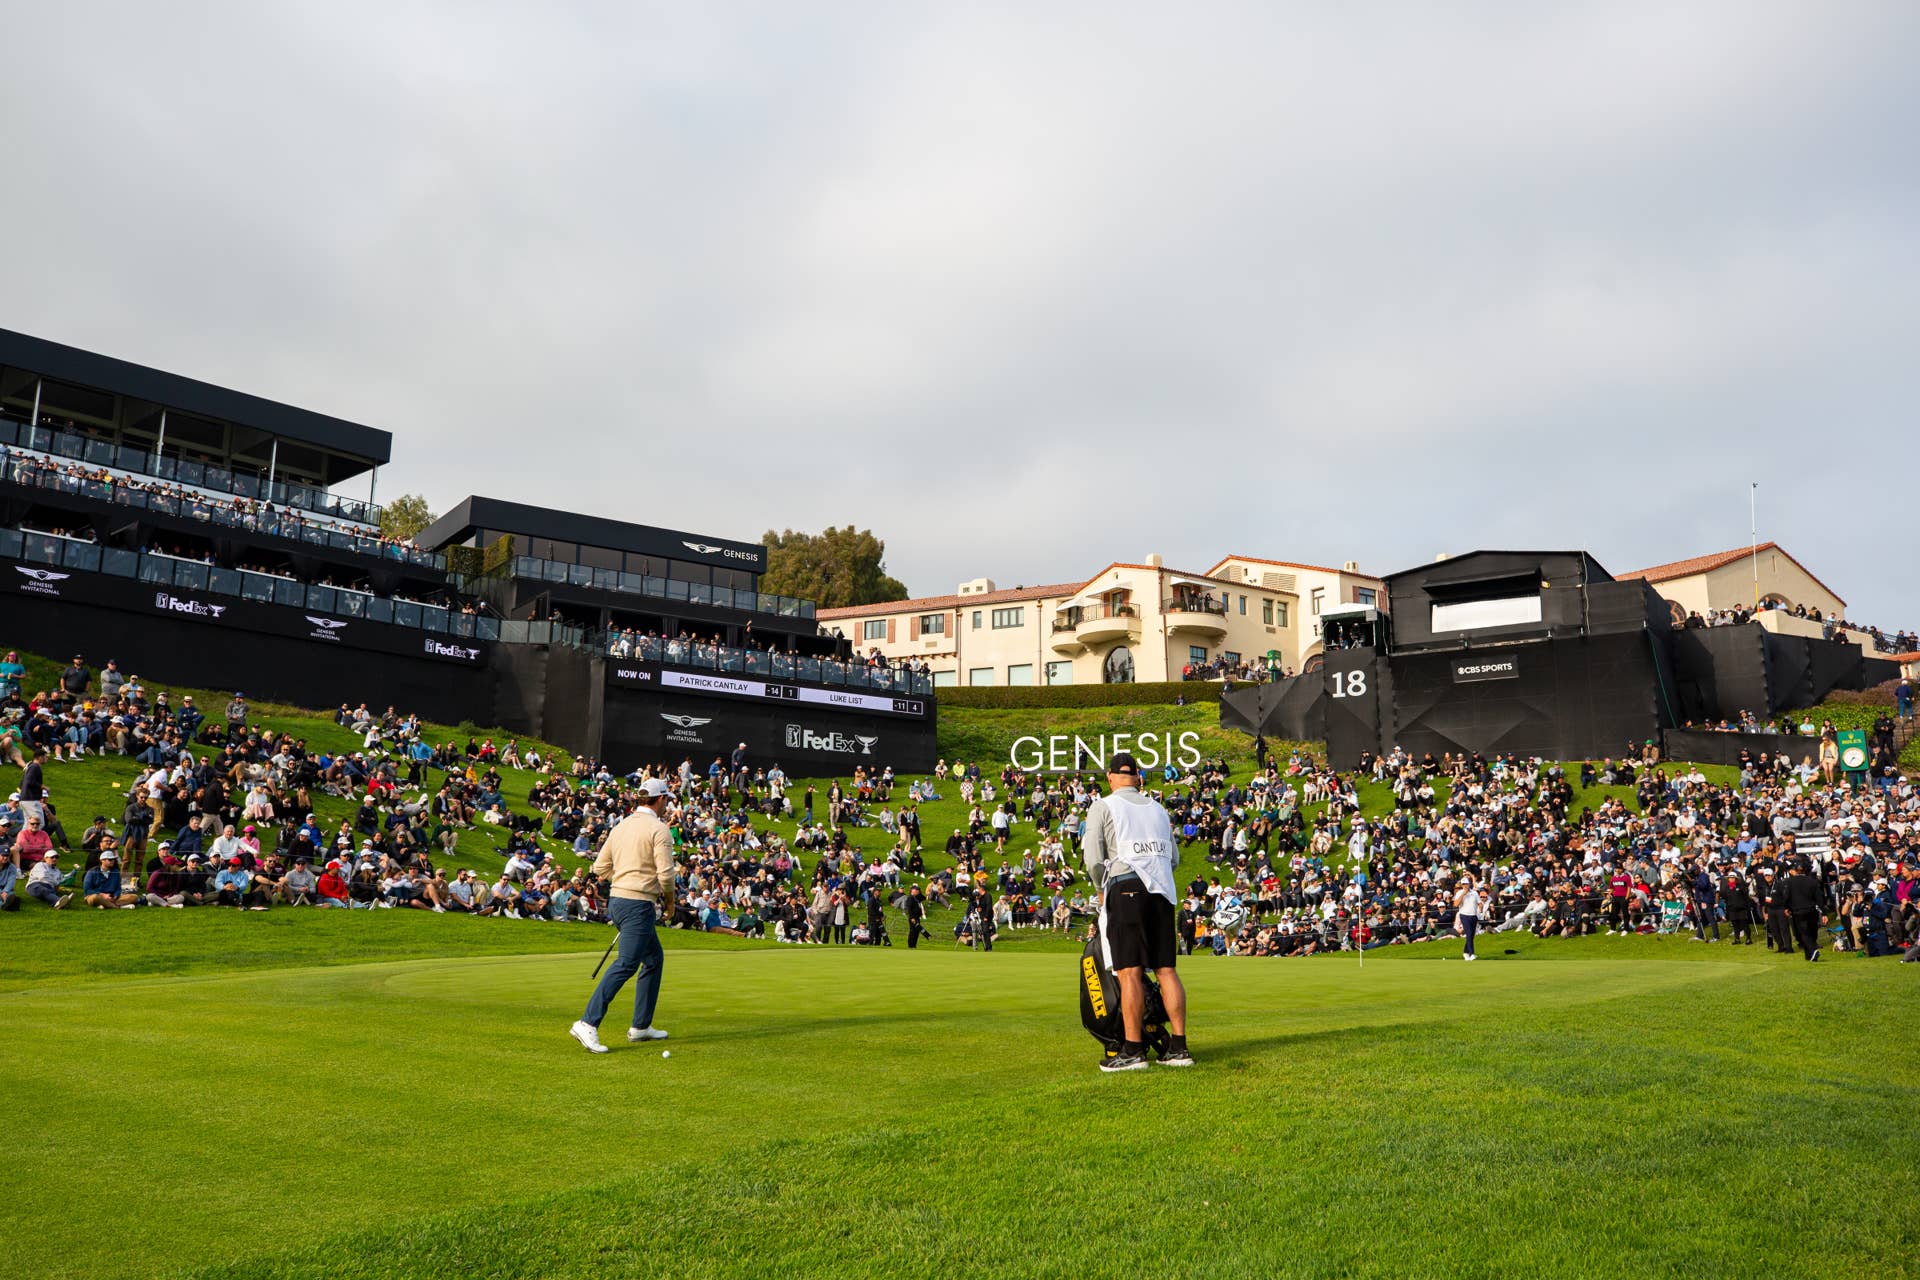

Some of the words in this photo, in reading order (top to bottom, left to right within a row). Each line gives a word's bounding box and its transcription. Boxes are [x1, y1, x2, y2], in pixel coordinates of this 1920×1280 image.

[723, 549, 758, 561] GENESIS
[20, 585, 60, 595] INVITATIONAL
[28, 580, 53, 589] GENESIS
[169, 597, 208, 616] FedEx
[435, 642, 467, 658] FedEx
[1463, 665, 1481, 674] CBS
[1481, 663, 1513, 673] SPORTS
[617, 669, 637, 679] NOW
[638, 671, 651, 680] ON
[679, 676, 713, 688] PATRICK
[713, 680, 748, 691] CANTLAY
[1331, 670, 1367, 698] 18
[767, 687, 778, 695] -14
[788, 689, 793, 697] 1
[829, 694, 847, 703] LUKE
[848, 696, 863, 705] LIST
[894, 702, 905, 710] -11
[912, 704, 917, 712] 4
[673, 729, 697, 737] GENESIS
[666, 735, 703, 744] INVITATIONAL
[803, 729, 855, 753] FedEx
[1010, 731, 1201, 772] GENESIS
[1083, 955, 1108, 1019] DEWALT
